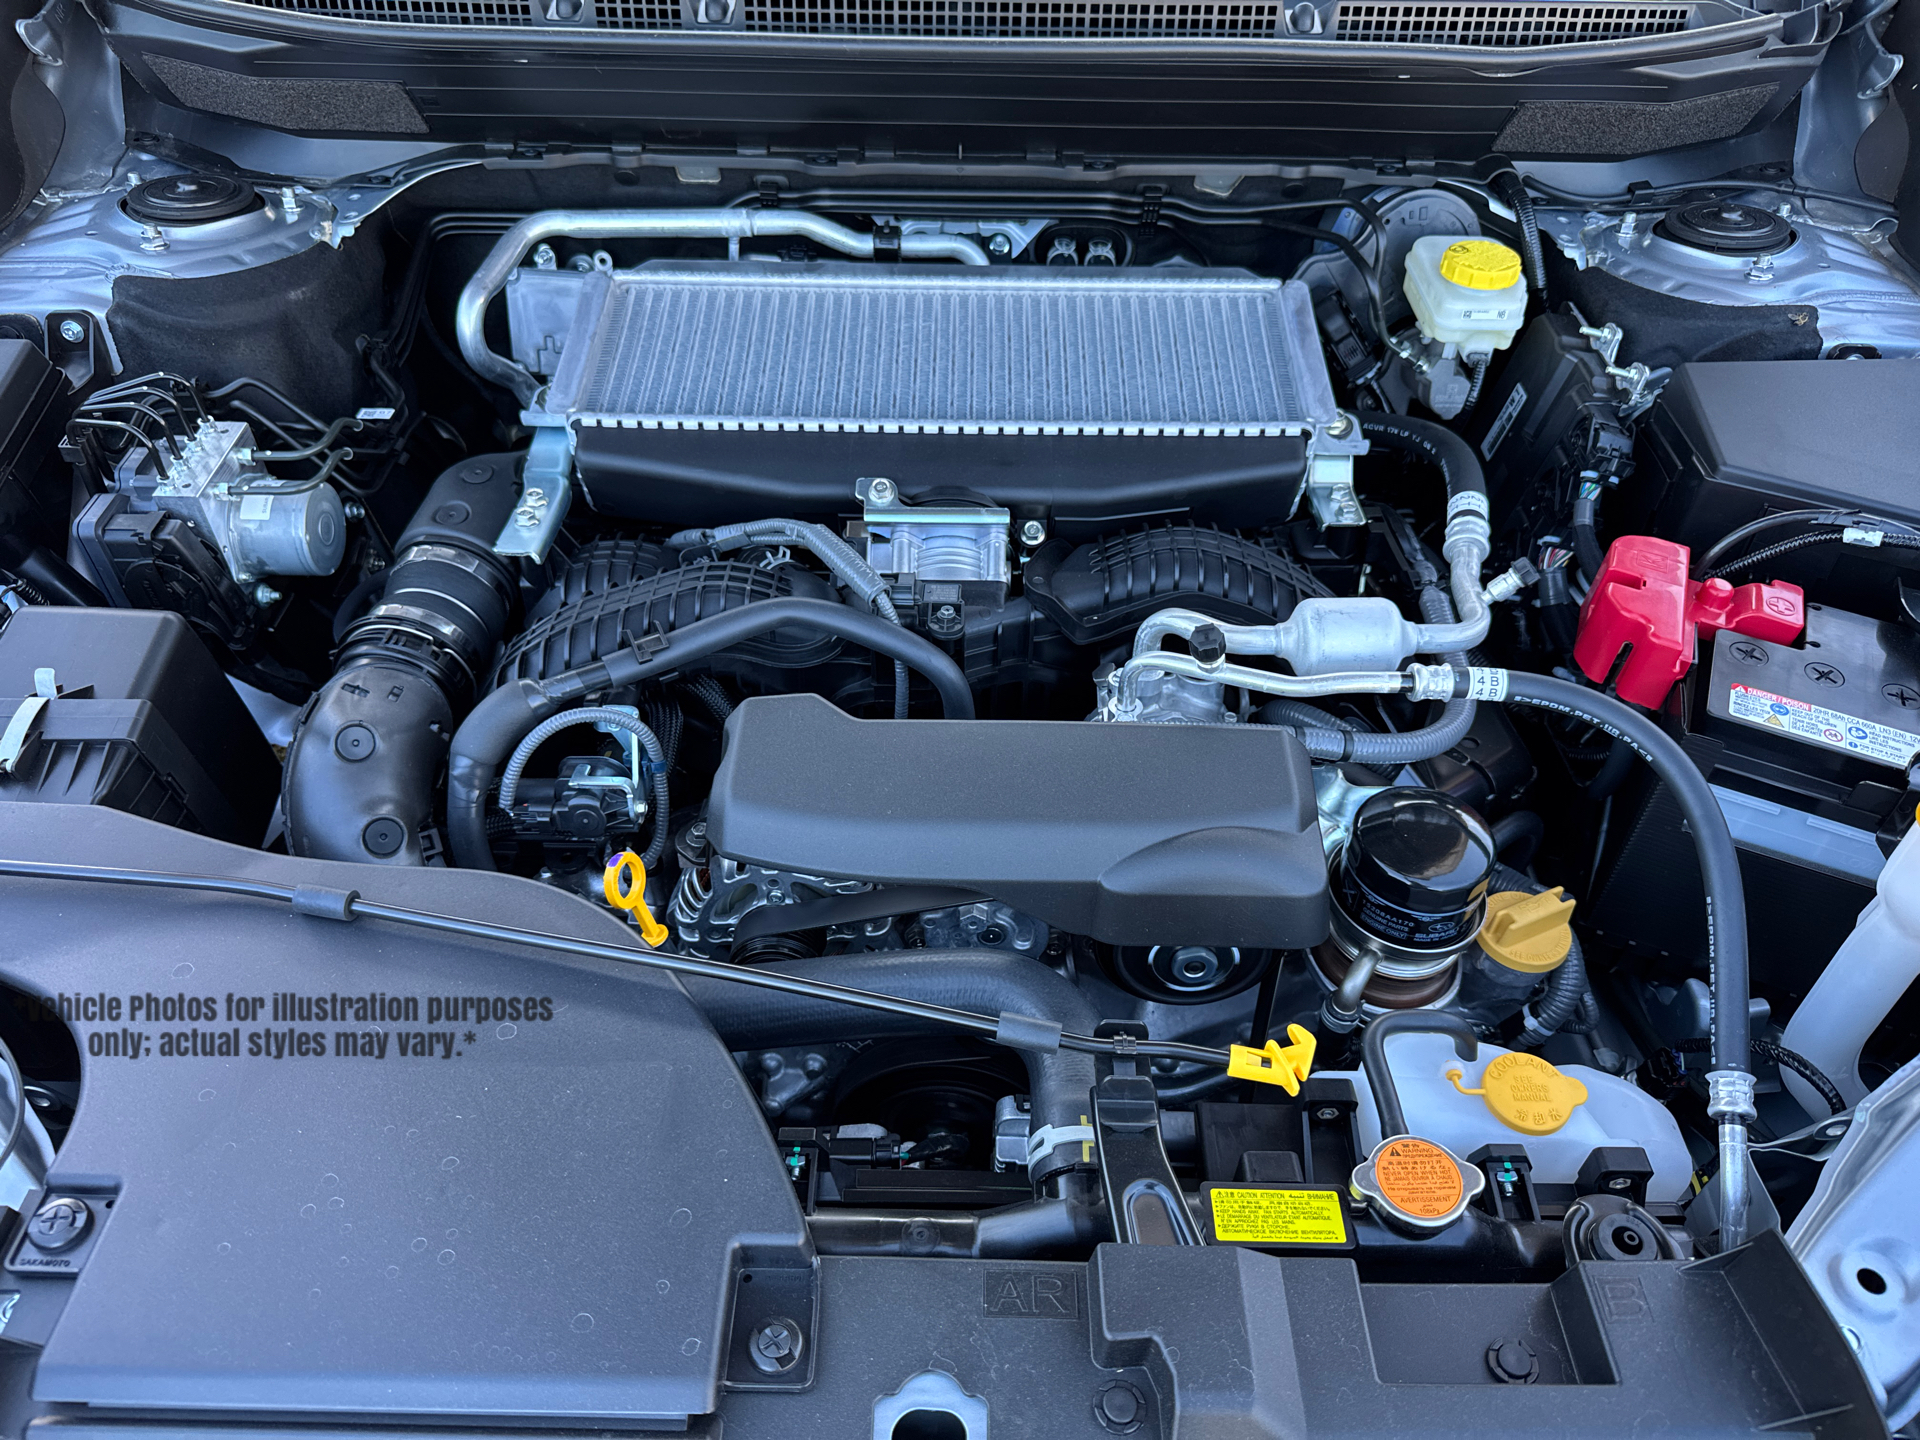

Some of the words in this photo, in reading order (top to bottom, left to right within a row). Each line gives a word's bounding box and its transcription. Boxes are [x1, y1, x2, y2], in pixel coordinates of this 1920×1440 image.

[1477, 676, 1485, 686] 4
[1491, 676, 1499, 686] B
[1747, 688, 1777, 702] DANGER
[1781, 698, 1809, 711] POISON
[1847, 717, 1860, 726] CCA
[1362, 900, 1416, 927] 15208AA170
[1388, 920, 1410, 932] PARTS
[1386, 928, 1405, 939] ONLY
[1489, 1055, 1559, 1080] COOLANT
[1513, 1075, 1532, 1084] SEE
[1512, 1093, 1552, 1102] MANUAL
[19, 1258, 71, 1268] SAKAMOTO
[990, 1273, 1070, 1312] AR
